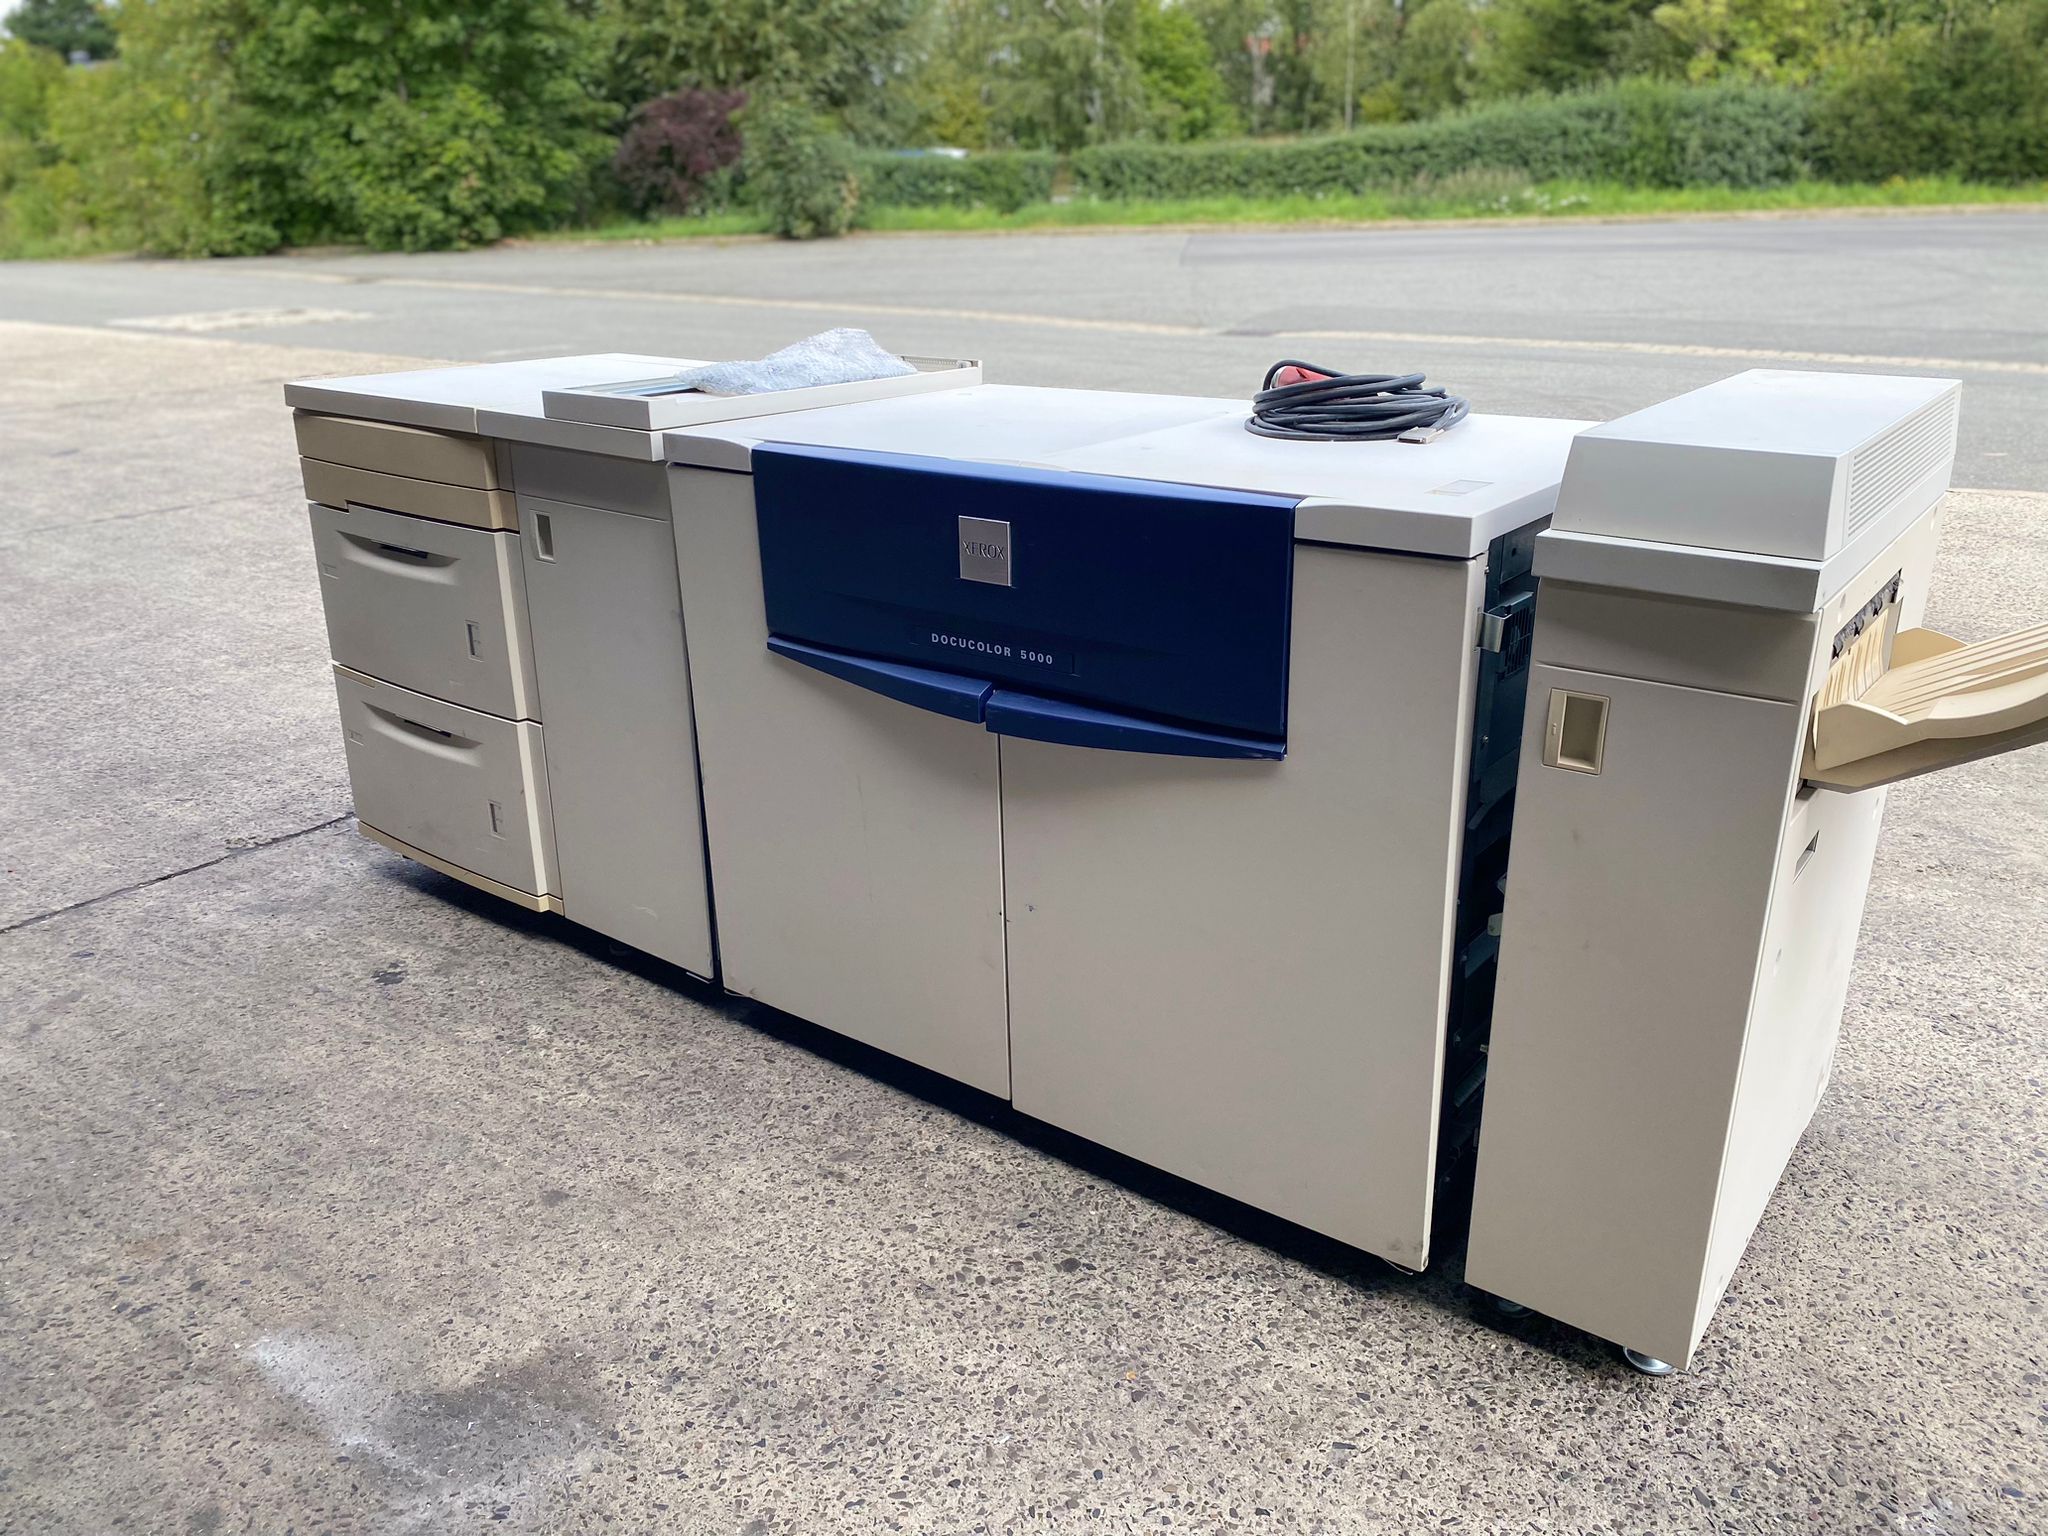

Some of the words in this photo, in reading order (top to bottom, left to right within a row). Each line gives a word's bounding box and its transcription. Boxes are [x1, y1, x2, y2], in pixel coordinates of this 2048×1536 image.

[962, 541, 1005, 560] XEROX
[931, 633, 1011, 657] DOCUCOLOR
[1020, 650, 1053, 665] 5000
